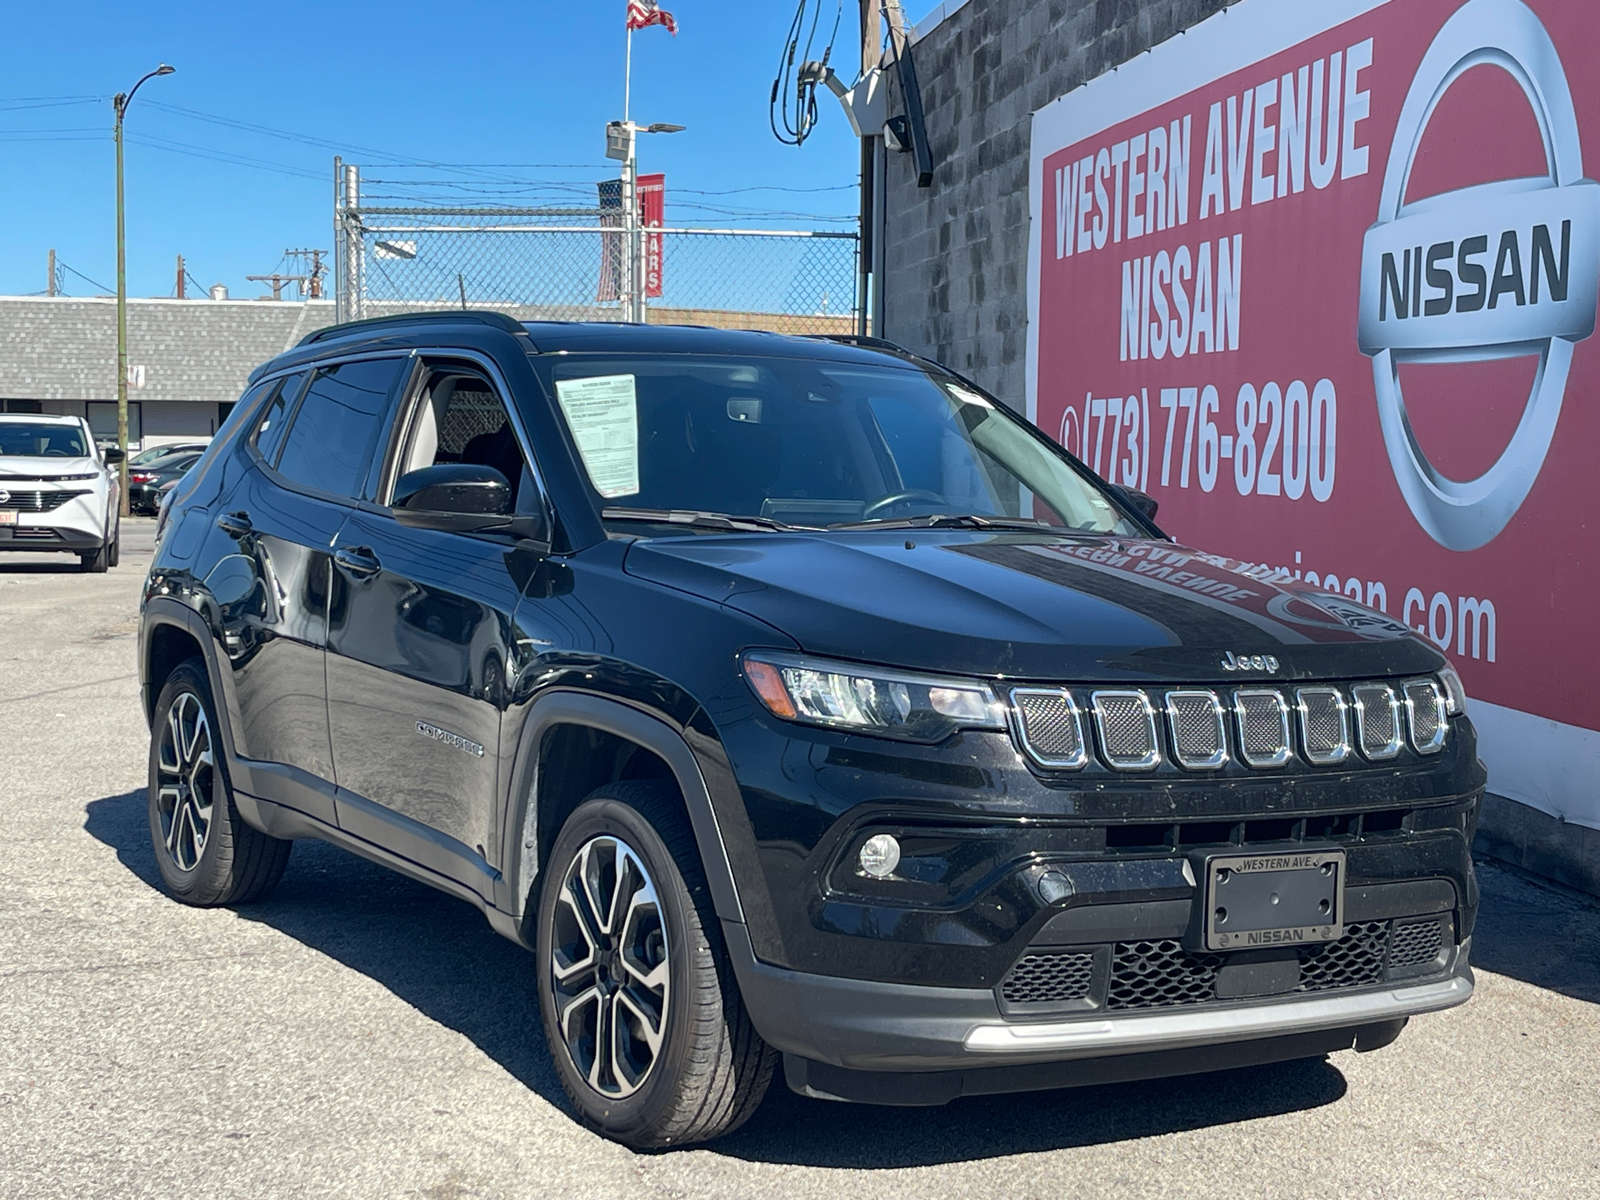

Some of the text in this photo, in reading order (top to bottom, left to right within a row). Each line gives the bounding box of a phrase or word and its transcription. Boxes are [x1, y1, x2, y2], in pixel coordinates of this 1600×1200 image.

[1055, 37, 1374, 260] WESTERN AVENUE
[648, 220, 660, 288] CARS
[1378, 219, 1571, 322] NISSAN
[1119, 234, 1243, 362] NISSAN
[1083, 378, 1336, 502] (773) 776-8200
[1220, 650, 1280, 674] Jeep
[1243, 858, 1290, 871] WESTERN
[1247, 929, 1304, 944] NISSAN
